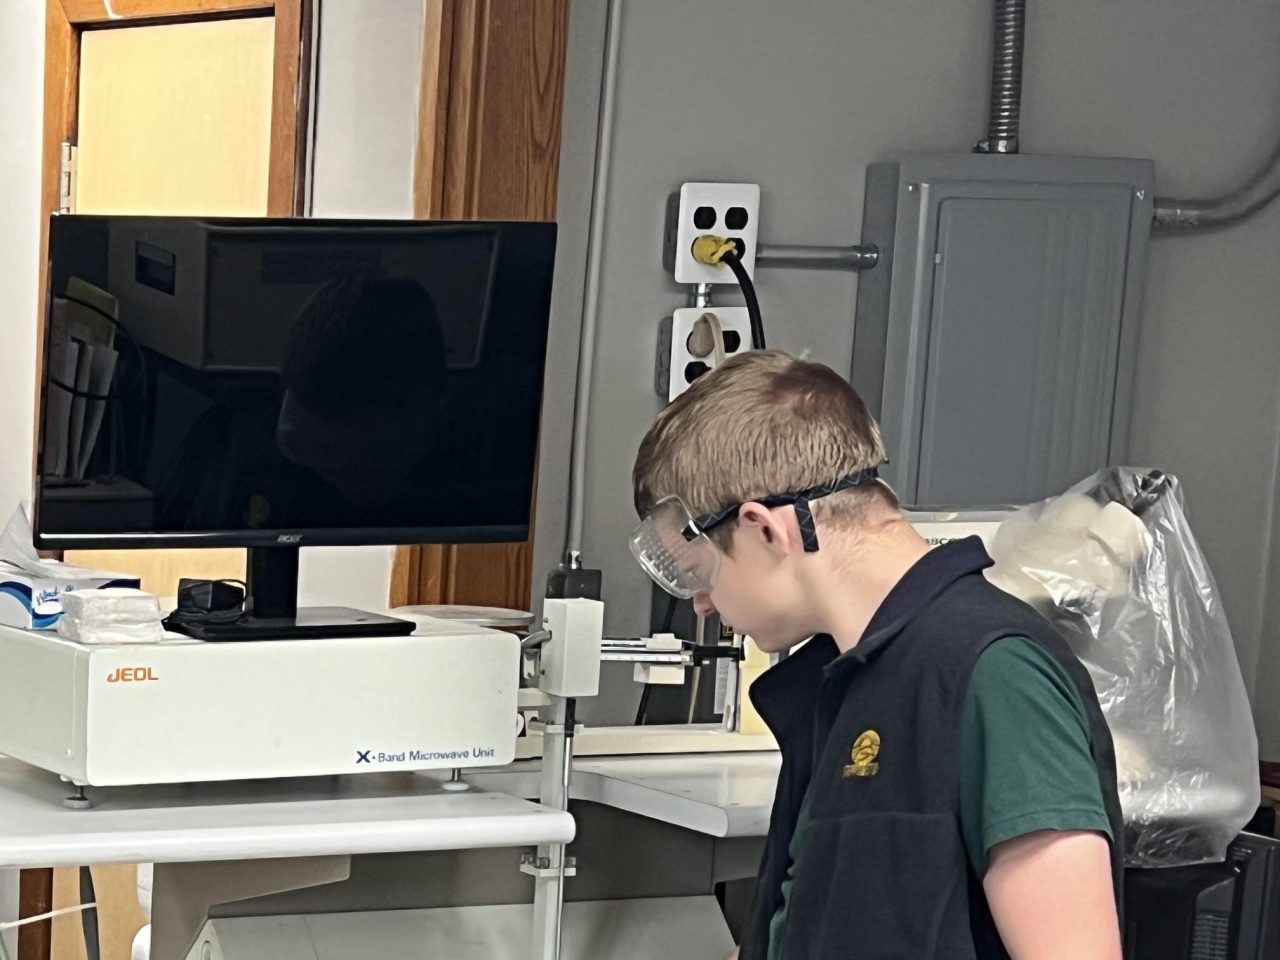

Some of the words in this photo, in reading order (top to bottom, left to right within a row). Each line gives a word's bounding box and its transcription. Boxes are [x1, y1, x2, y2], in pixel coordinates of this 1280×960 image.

[107, 667, 159, 682] JEOL
[409, 750, 469, 761] Microwave
[473, 748, 495, 758] Unit
